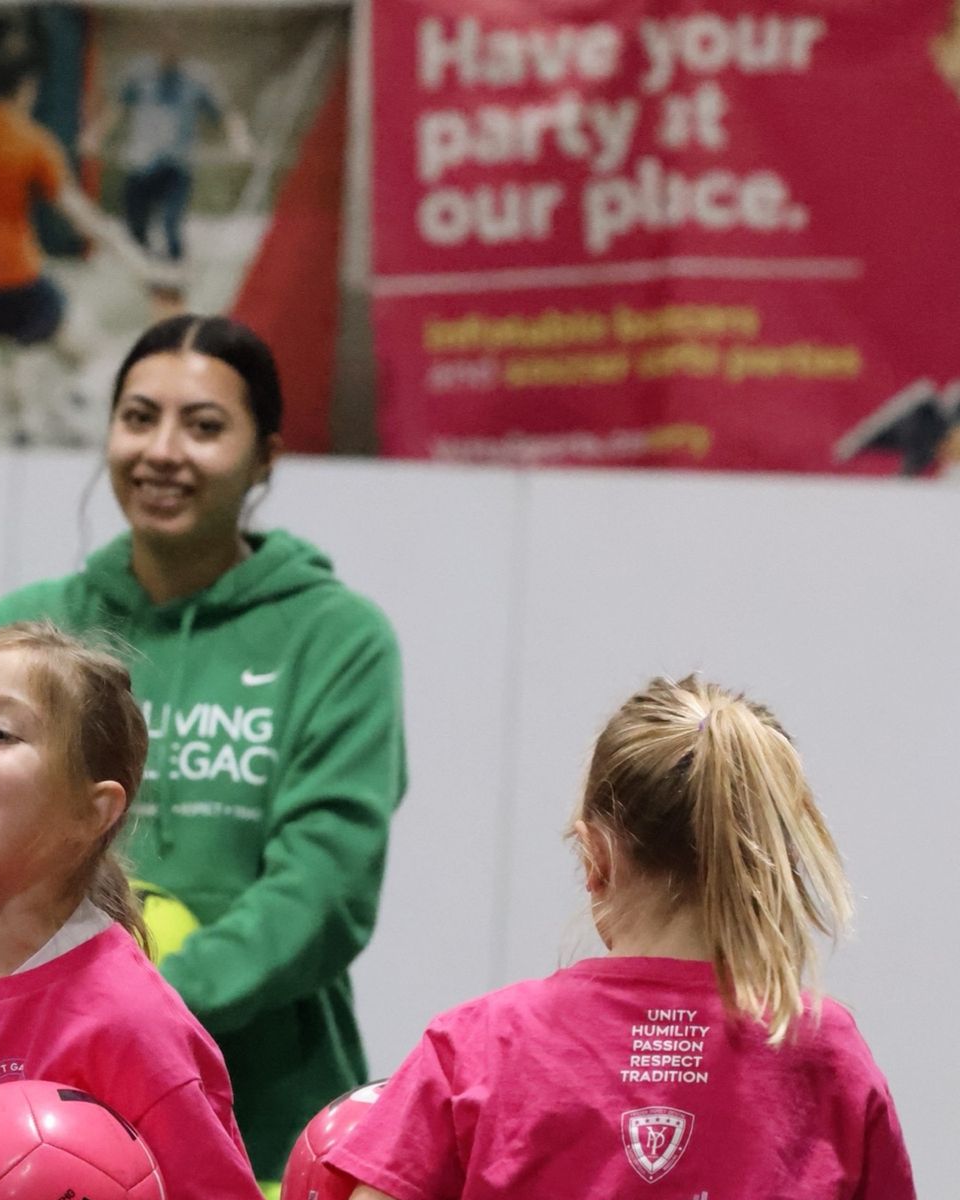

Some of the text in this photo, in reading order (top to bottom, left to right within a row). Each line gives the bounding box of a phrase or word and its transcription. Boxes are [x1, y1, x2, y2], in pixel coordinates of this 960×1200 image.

[419, 14, 824, 93] Have your
[419, 89, 638, 182] party
[417, 183, 563, 245] our
[647, 1009, 698, 1022] UNITY
[631, 1024, 710, 1038] HUMILITY
[632, 1040, 704, 1052] PASSION
[630, 1055, 703, 1068] RESPECT
[620, 1070, 709, 1083] TRADITION
